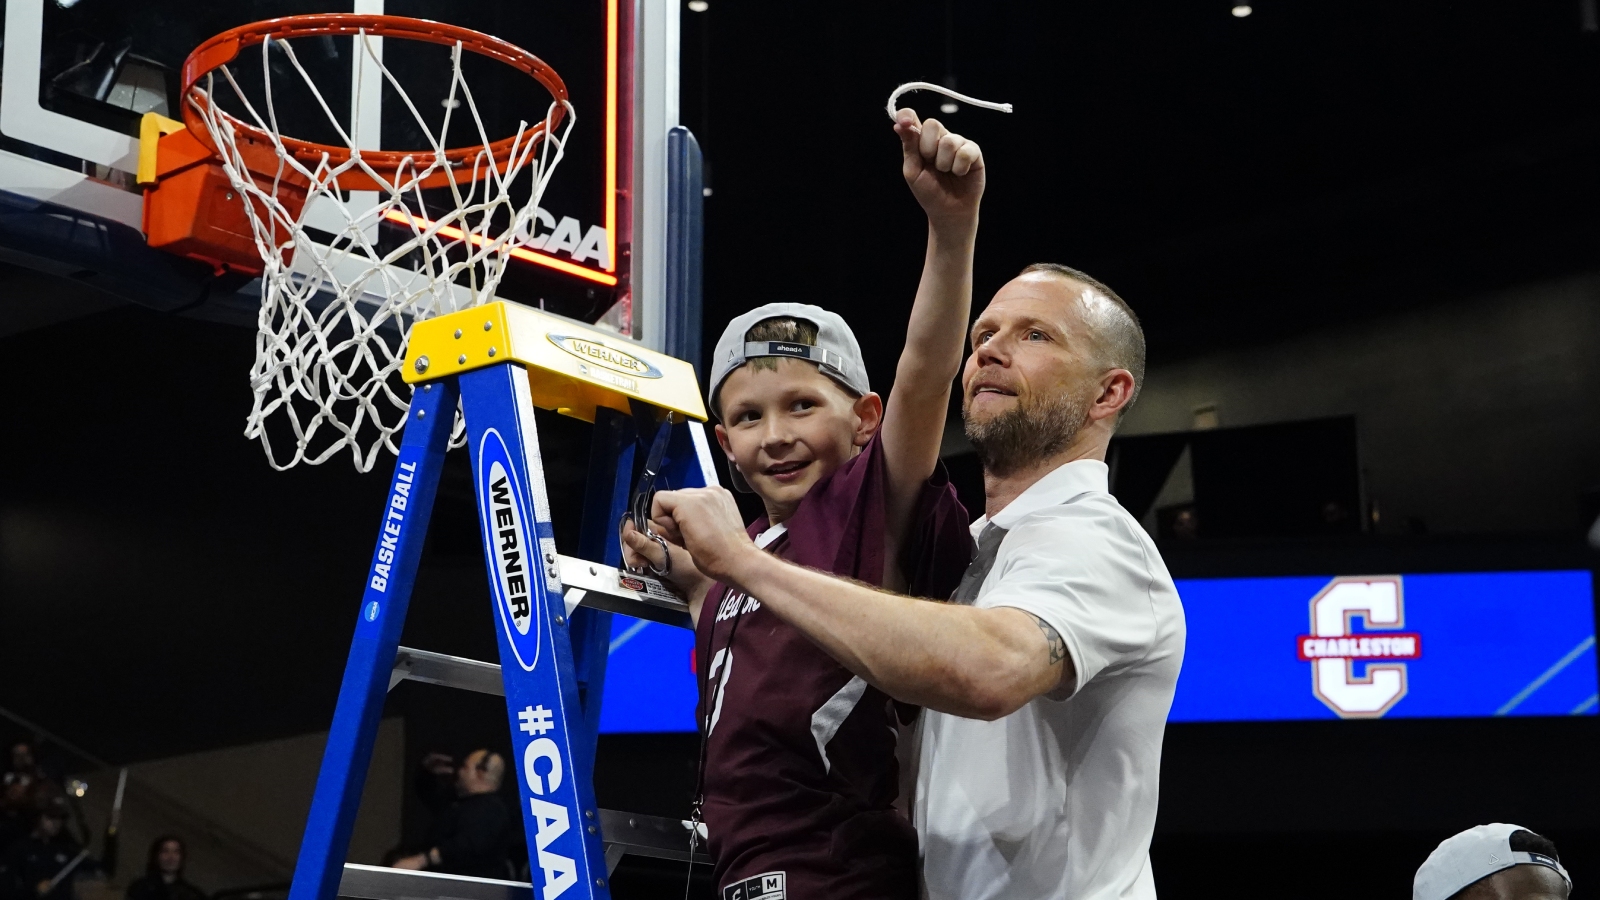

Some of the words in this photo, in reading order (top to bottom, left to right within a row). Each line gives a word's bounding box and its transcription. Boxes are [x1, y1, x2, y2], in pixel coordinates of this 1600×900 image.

[572, 341, 640, 371] WERNER
[777, 345, 798, 353] ahead
[371, 461, 416, 592] BASKETBALL
[491, 476, 530, 620] WERNER
[1303, 637, 1416, 657] CHARLESTON
[517, 704, 578, 900] #CAA
[766, 878, 777, 889] M
